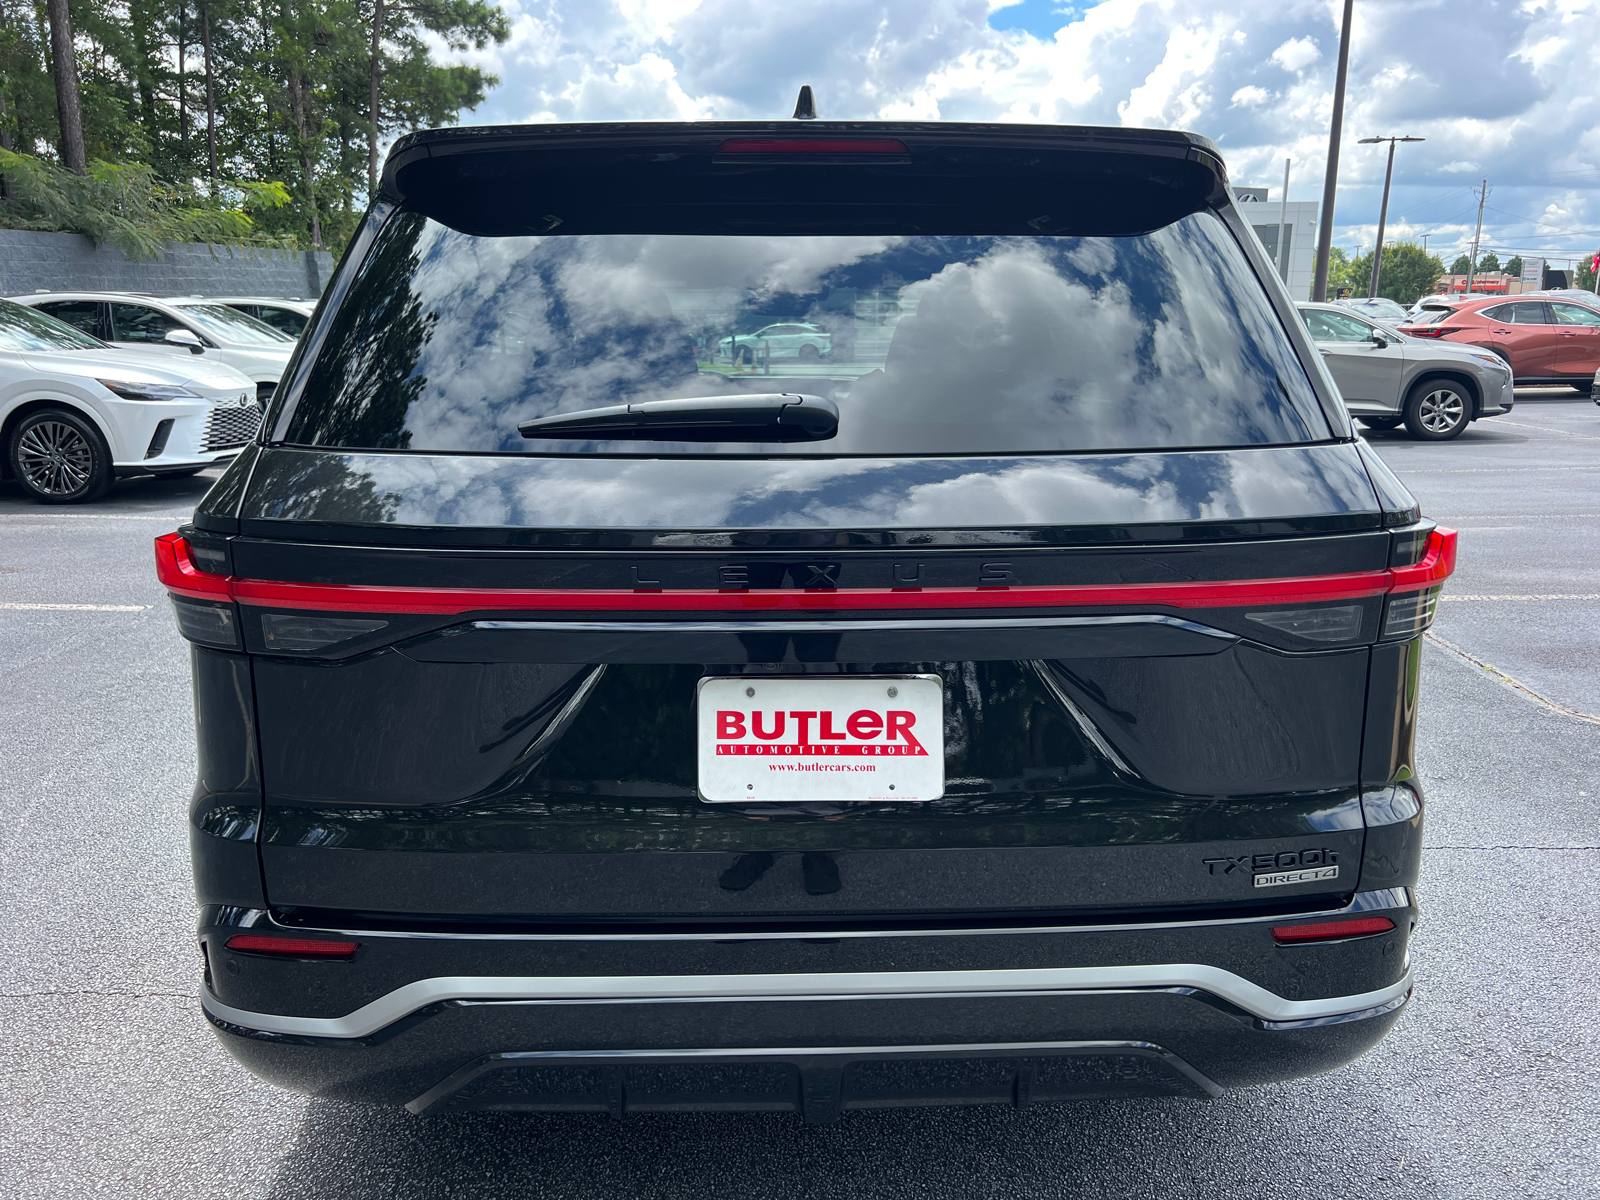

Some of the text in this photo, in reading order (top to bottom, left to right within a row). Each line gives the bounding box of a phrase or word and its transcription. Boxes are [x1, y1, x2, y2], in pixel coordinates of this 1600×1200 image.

[630, 561, 1014, 585] LEXUS
[717, 745, 922, 755] AUTOMOTIVE GROUP
[768, 762, 876, 772] www.butlercars.com
[1256, 868, 1337, 885] DIRECT4
